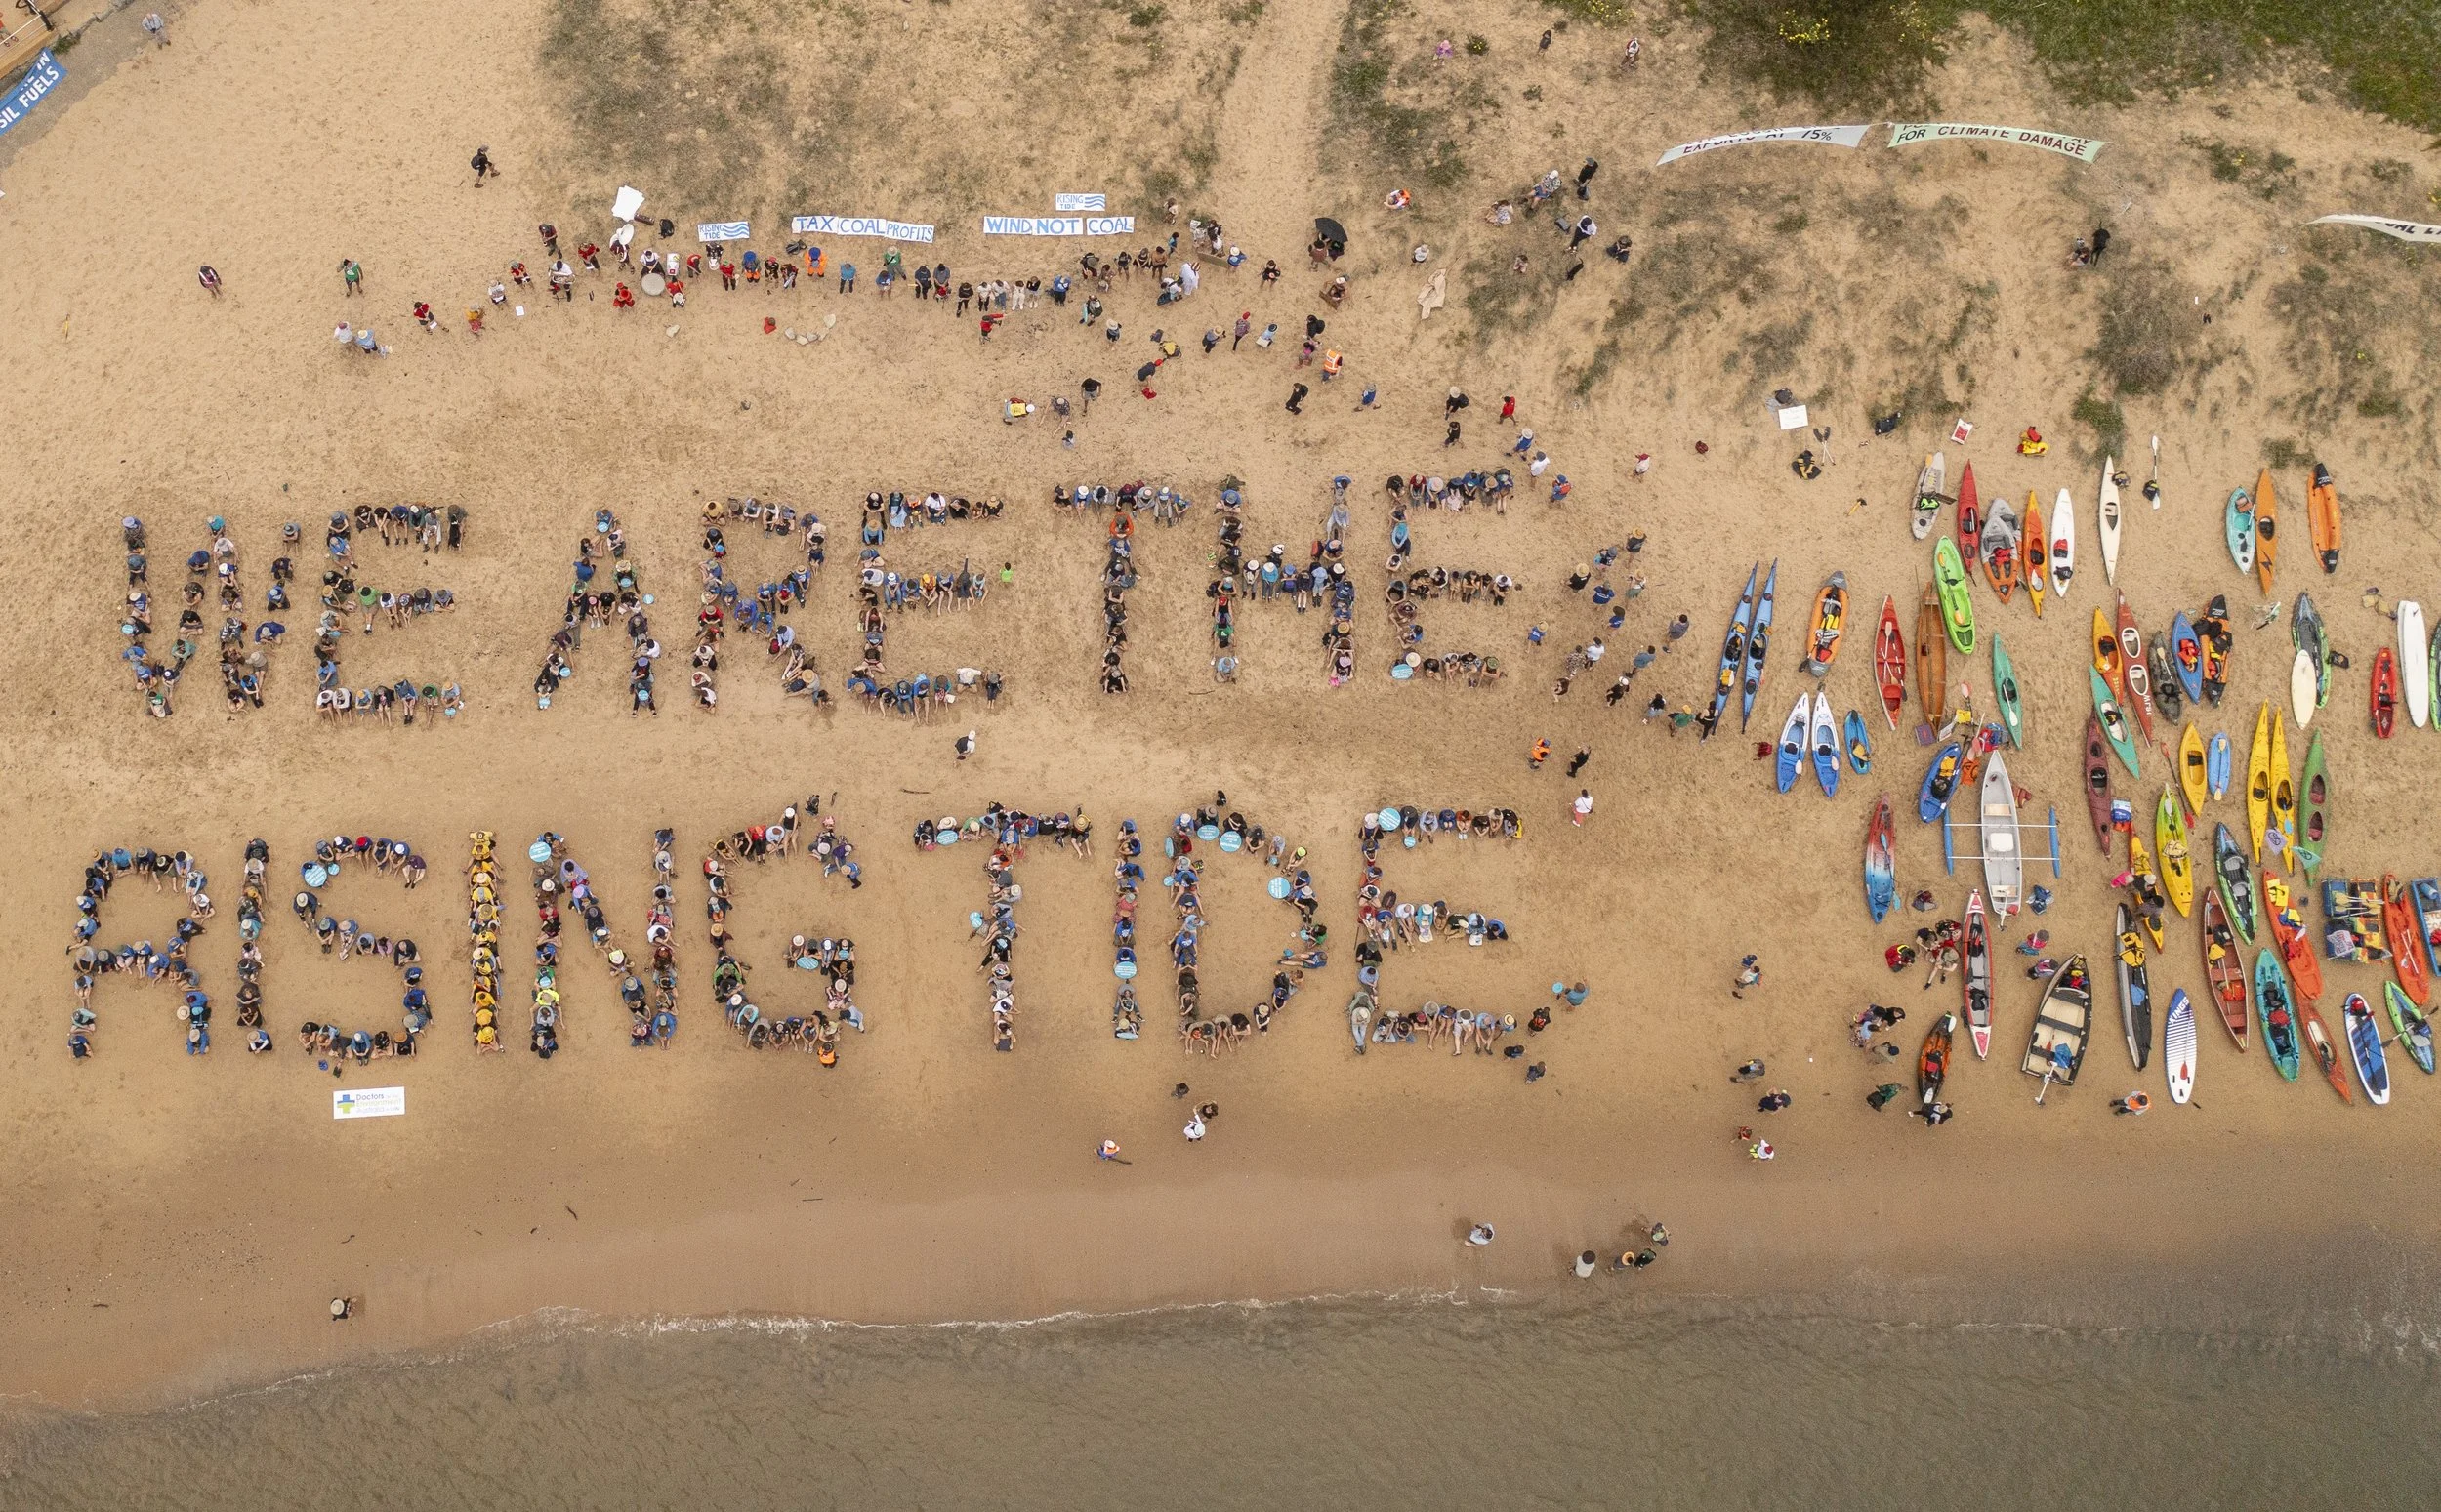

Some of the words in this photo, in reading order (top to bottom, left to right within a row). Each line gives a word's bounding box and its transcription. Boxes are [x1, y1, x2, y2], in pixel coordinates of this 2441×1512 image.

[19, 66, 59, 108] FUELS
[1897, 129, 1926, 143] FOR
[1938, 126, 2009, 138] CLIMATE
[2019, 132, 2087, 156] DAMAGE
[1056, 194, 1084, 204] RISING
[699, 224, 724, 232] RISING
[796, 216, 834, 231] TAX
[840, 219, 885, 234] COAL
[886, 223, 933, 242] PROFITS
[986, 217, 1032, 233] WIND
[1036, 219, 1080, 234] NOT
[1088, 217, 1134, 234] COAL
[119, 502, 467, 724] WE
[533, 490, 1004, 726] ARE
[1053, 469, 1515, 694] THE
[66, 802, 866, 1068] RISING
[914, 795, 1523, 1058] TIDE
[2169, 997, 2190, 1024] KINGS
